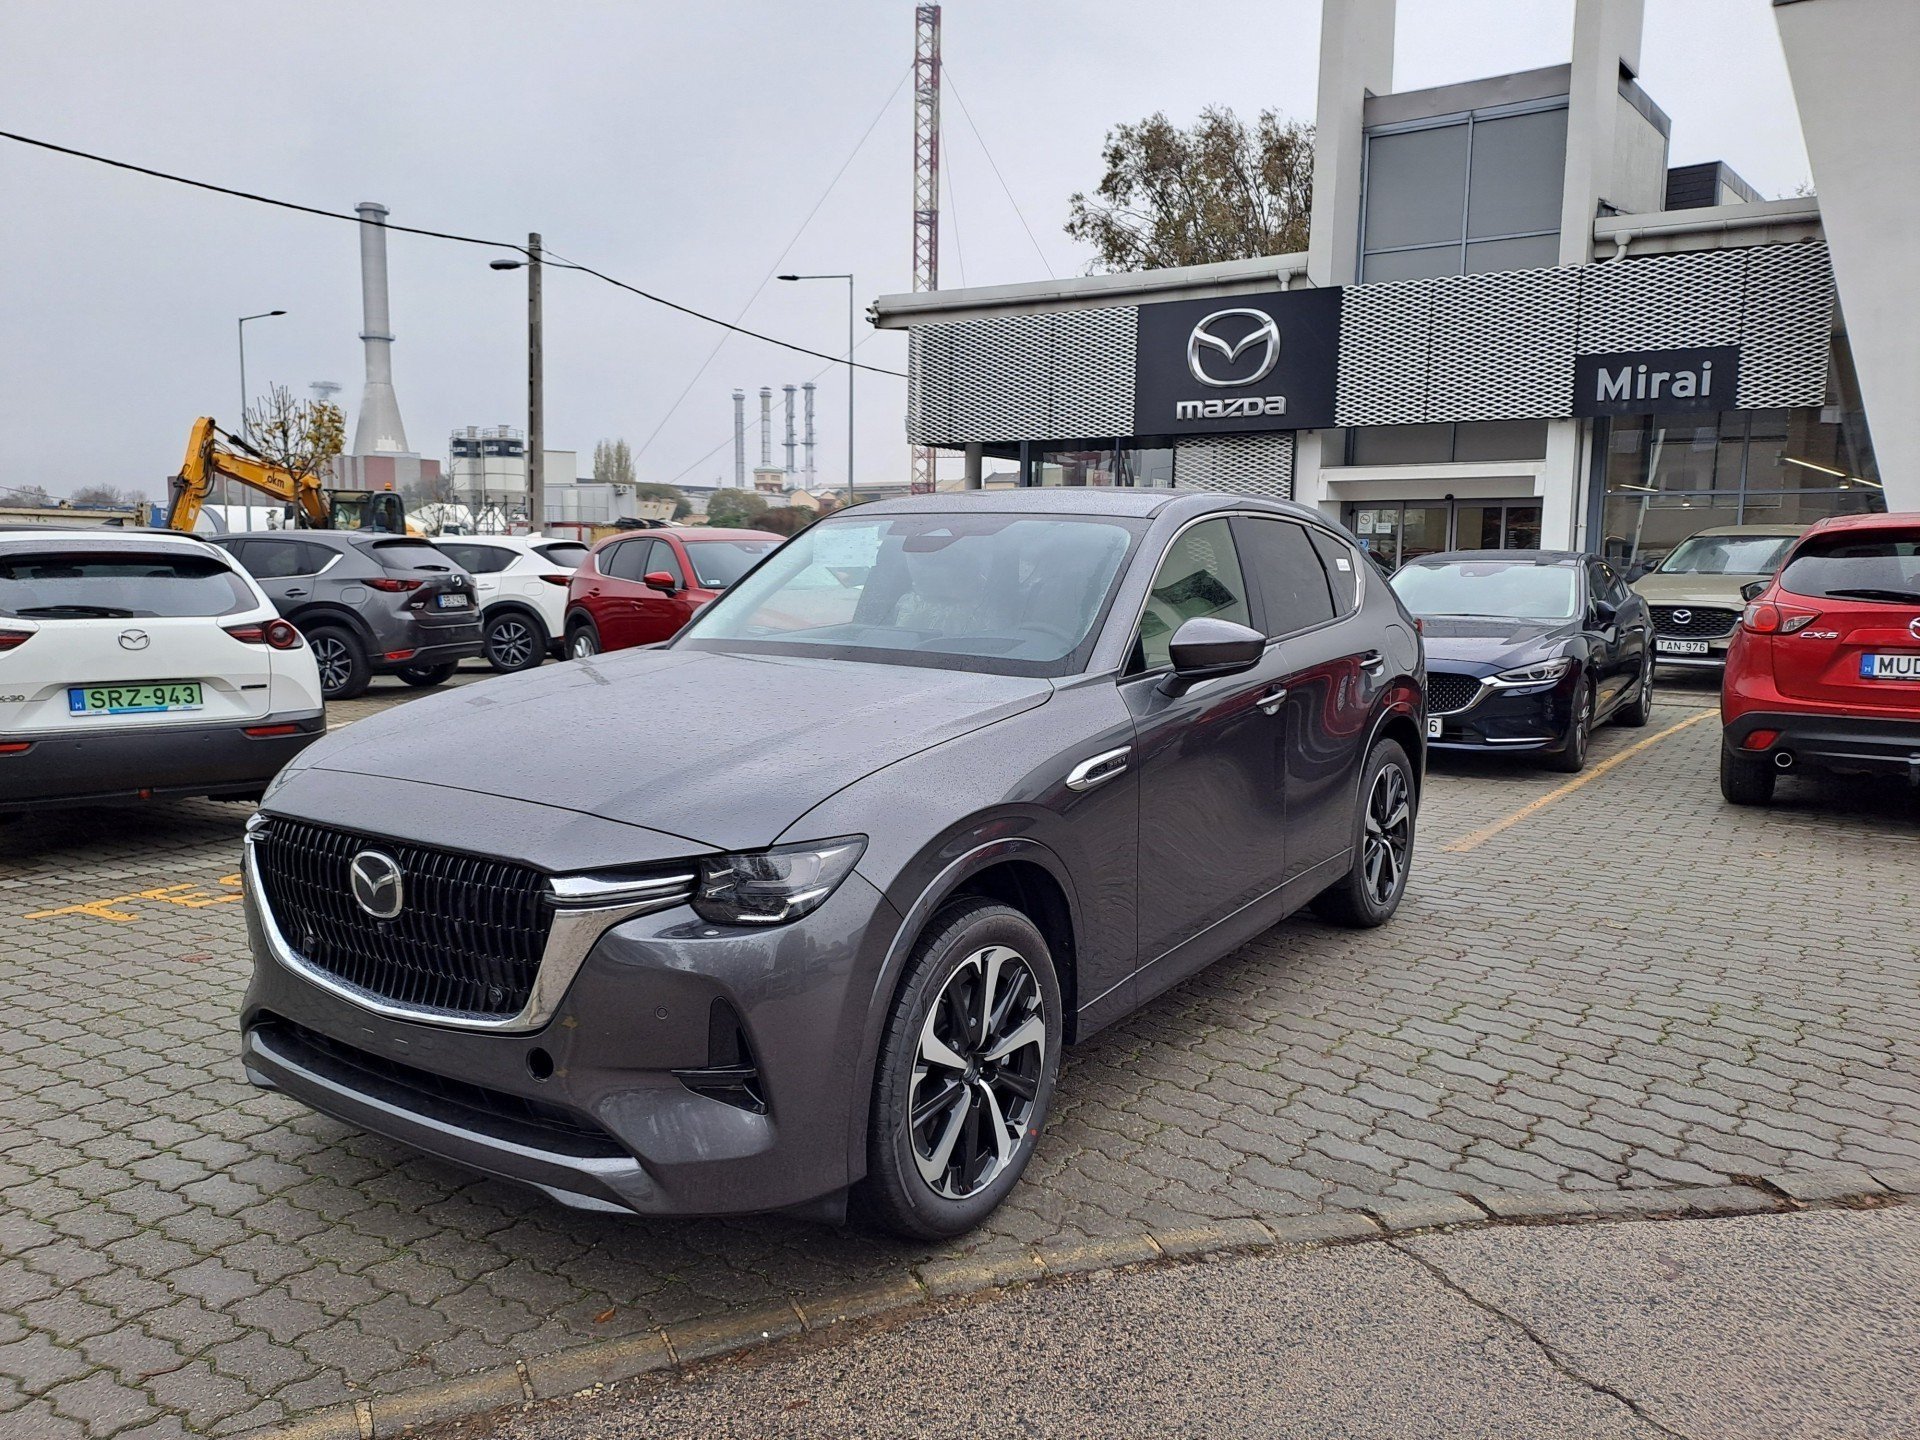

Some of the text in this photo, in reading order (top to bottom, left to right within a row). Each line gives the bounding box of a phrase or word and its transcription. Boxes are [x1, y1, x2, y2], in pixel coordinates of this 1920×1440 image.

[1596, 360, 1712, 402] Mirai
[1176, 395, 1287, 420] mazda
[1659, 641, 1706, 652] TAN-976
[1800, 631, 1839, 639] CX-5
[90, 686, 195, 709] SRZ-943
